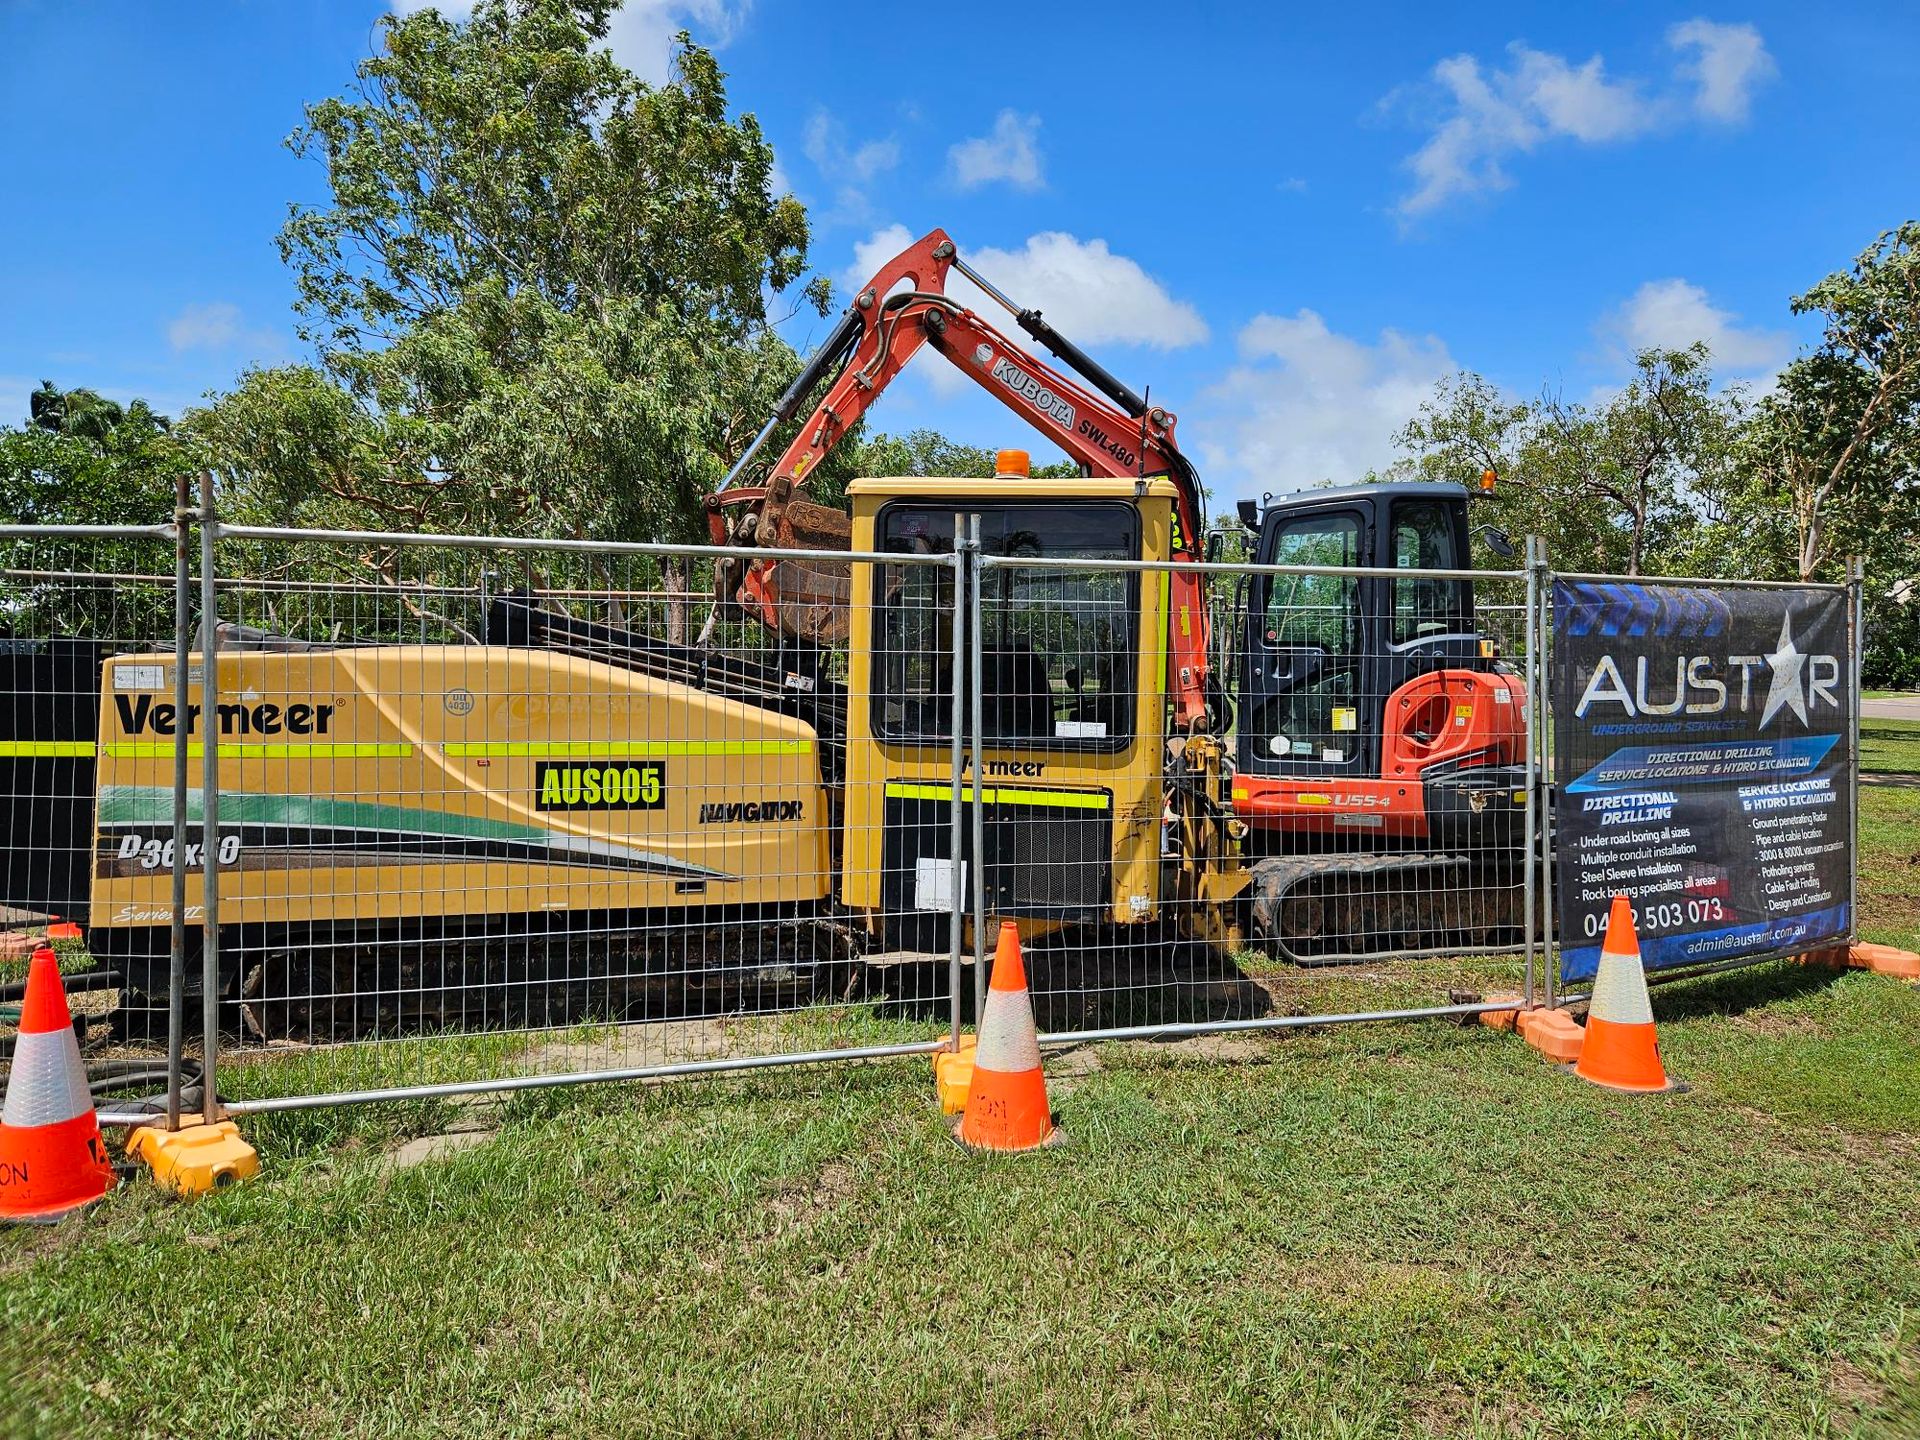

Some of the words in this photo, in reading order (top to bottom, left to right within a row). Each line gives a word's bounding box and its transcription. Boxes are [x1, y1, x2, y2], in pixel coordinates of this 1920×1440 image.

[991, 356, 1076, 430] KUBOTA
[1079, 419, 1135, 467] SWL480
[1591, 722, 1682, 736] UNDERGROUND
[1684, 720, 1735, 732] SERVICES
[961, 755, 1045, 777] meer
[1647, 749, 1722, 764] DIRECTIONAL
[1597, 768, 1649, 782] SERVICE
[1647, 764, 1709, 779] LOCATIONS
[1711, 763, 1722, 774] &
[1723, 762, 1757, 774] HYDRO
[1758, 757, 1811, 771] EXCAVATION
[540, 767, 660, 805] AUS005
[1738, 784, 1780, 798] SERVICE
[1780, 778, 1831, 794] LOCATIONS
[1583, 792, 1679, 812] DIRECTIONAL
[1743, 801, 1752, 811] &
[1754, 796, 1788, 810] HYDRO
[1789, 791, 1837, 807] EXCAVATION
[699, 801, 803, 824] NAVIGATOR
[1601, 807, 1672, 826] DRILLING
[1752, 815, 1778, 830] Ground
[1779, 813, 1813, 828] penetrating
[1812, 810, 1828, 823] Radar
[1580, 834, 1609, 849] Under
[1610, 831, 1631, 845] road
[1632, 829, 1660, 843] boring
[1660, 827, 1670, 840] all
[1671, 827, 1691, 838] sizes
[1755, 834, 1772, 848] Pipe
[1772, 832, 1785, 844] and
[1785, 829, 1801, 842] cable
[1801, 828, 1823, 840] location
[118, 834, 241, 869] D36x0
[1580, 851, 1618, 866] Multiple
[1620, 847, 1652, 861] conduit
[1653, 843, 1697, 858] installation
[1759, 849, 1777, 862] 3000
[1778, 849, 1784, 859] &
[1581, 869, 1606, 884] Steel
[1606, 867, 1637, 881] Sleeve
[1638, 862, 1683, 877] Installation
[1762, 863, 1793, 879] Potholing
[1793, 861, 1815, 874] services
[1582, 887, 1606, 901] Rock
[1607, 885, 1639, 899] boring
[1639, 878, 1684, 897] specialists
[1684, 875, 1694, 888] all
[1695, 875, 1717, 887] areas
[1765, 880, 1786, 895] Cable
[1786, 878, 1800, 891] Fault
[1801, 877, 1820, 889] Finding
[1768, 898, 1792, 912] Design
[1792, 894, 1803, 906] and
[1803, 889, 1832, 904] Construction
[1584, 908, 1641, 938] 042
[1645, 903, 1684, 930] 503
[1688, 896, 1723, 924] 073
